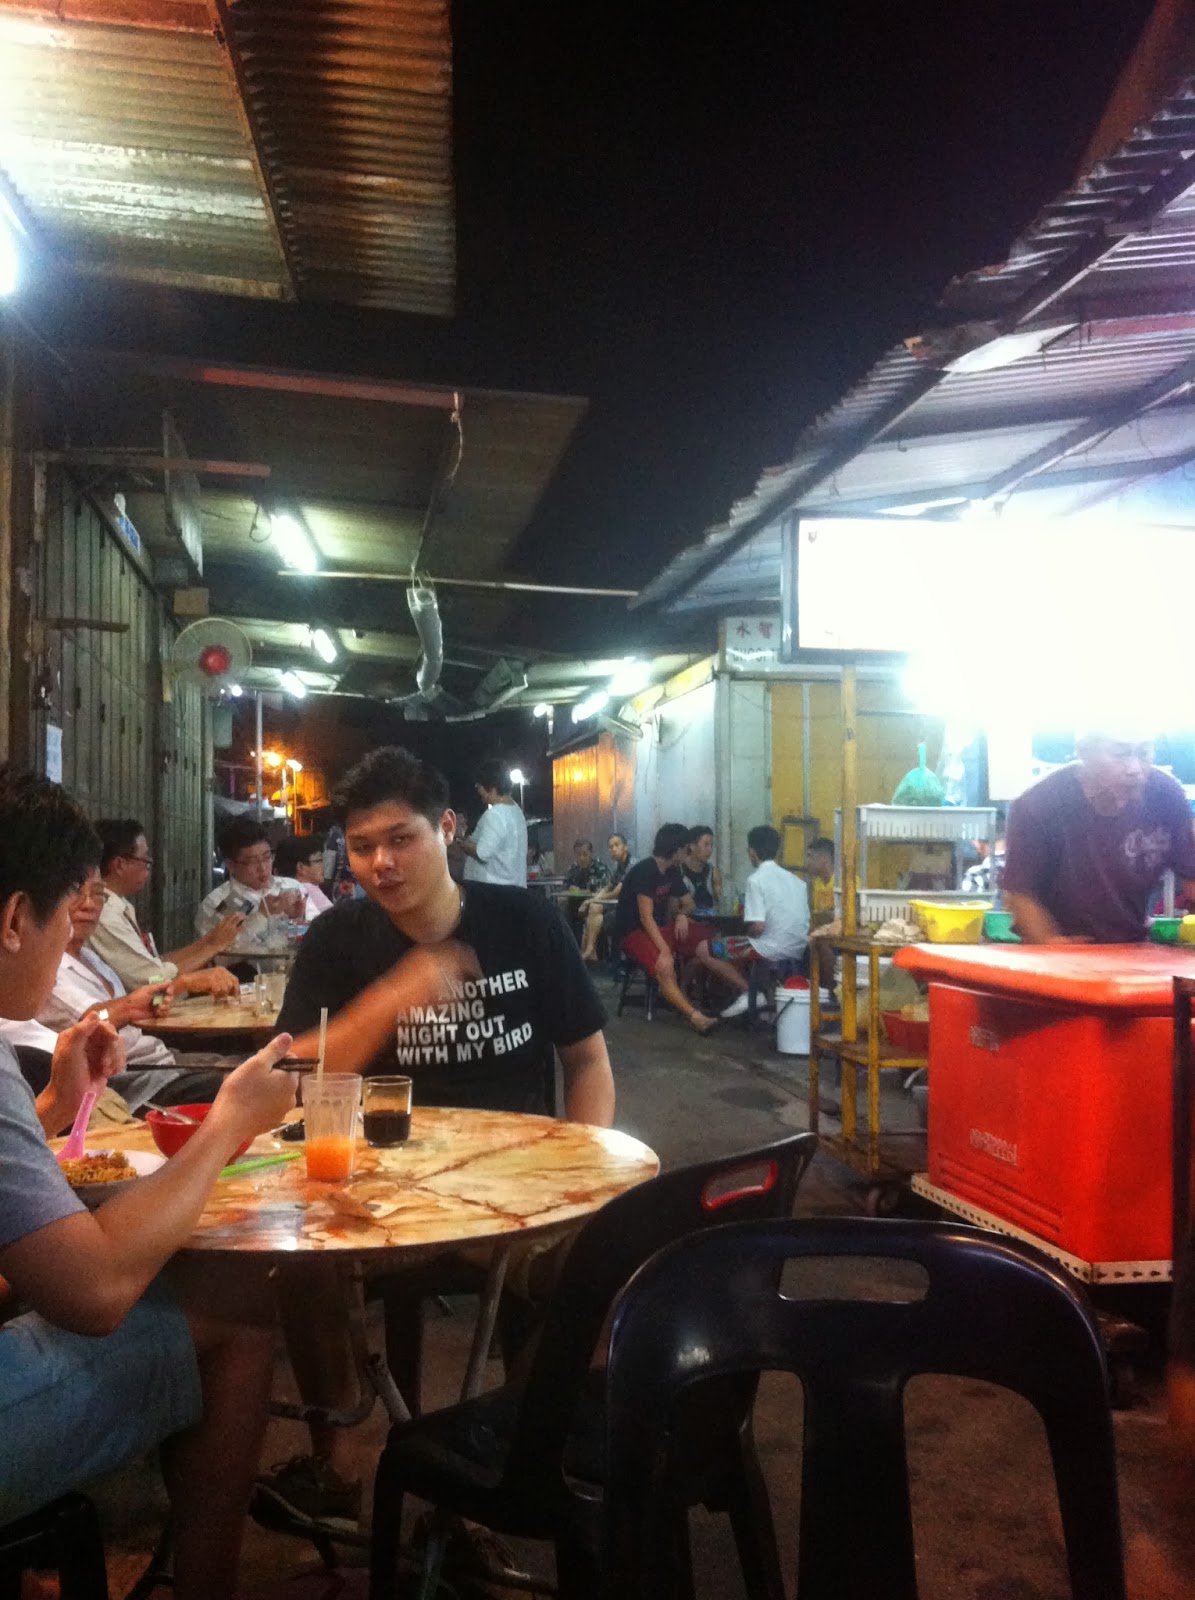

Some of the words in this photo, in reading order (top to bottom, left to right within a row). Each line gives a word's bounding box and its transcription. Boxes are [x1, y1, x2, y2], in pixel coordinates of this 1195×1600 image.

[398, 1000, 485, 1024] AMAZING
[397, 1024, 458, 1045] NIGHT
[466, 1014, 506, 1041] OUT
[397, 1046, 449, 1066] WITH
[456, 1041, 485, 1062] MY
[493, 1022, 533, 1056] BIRD
